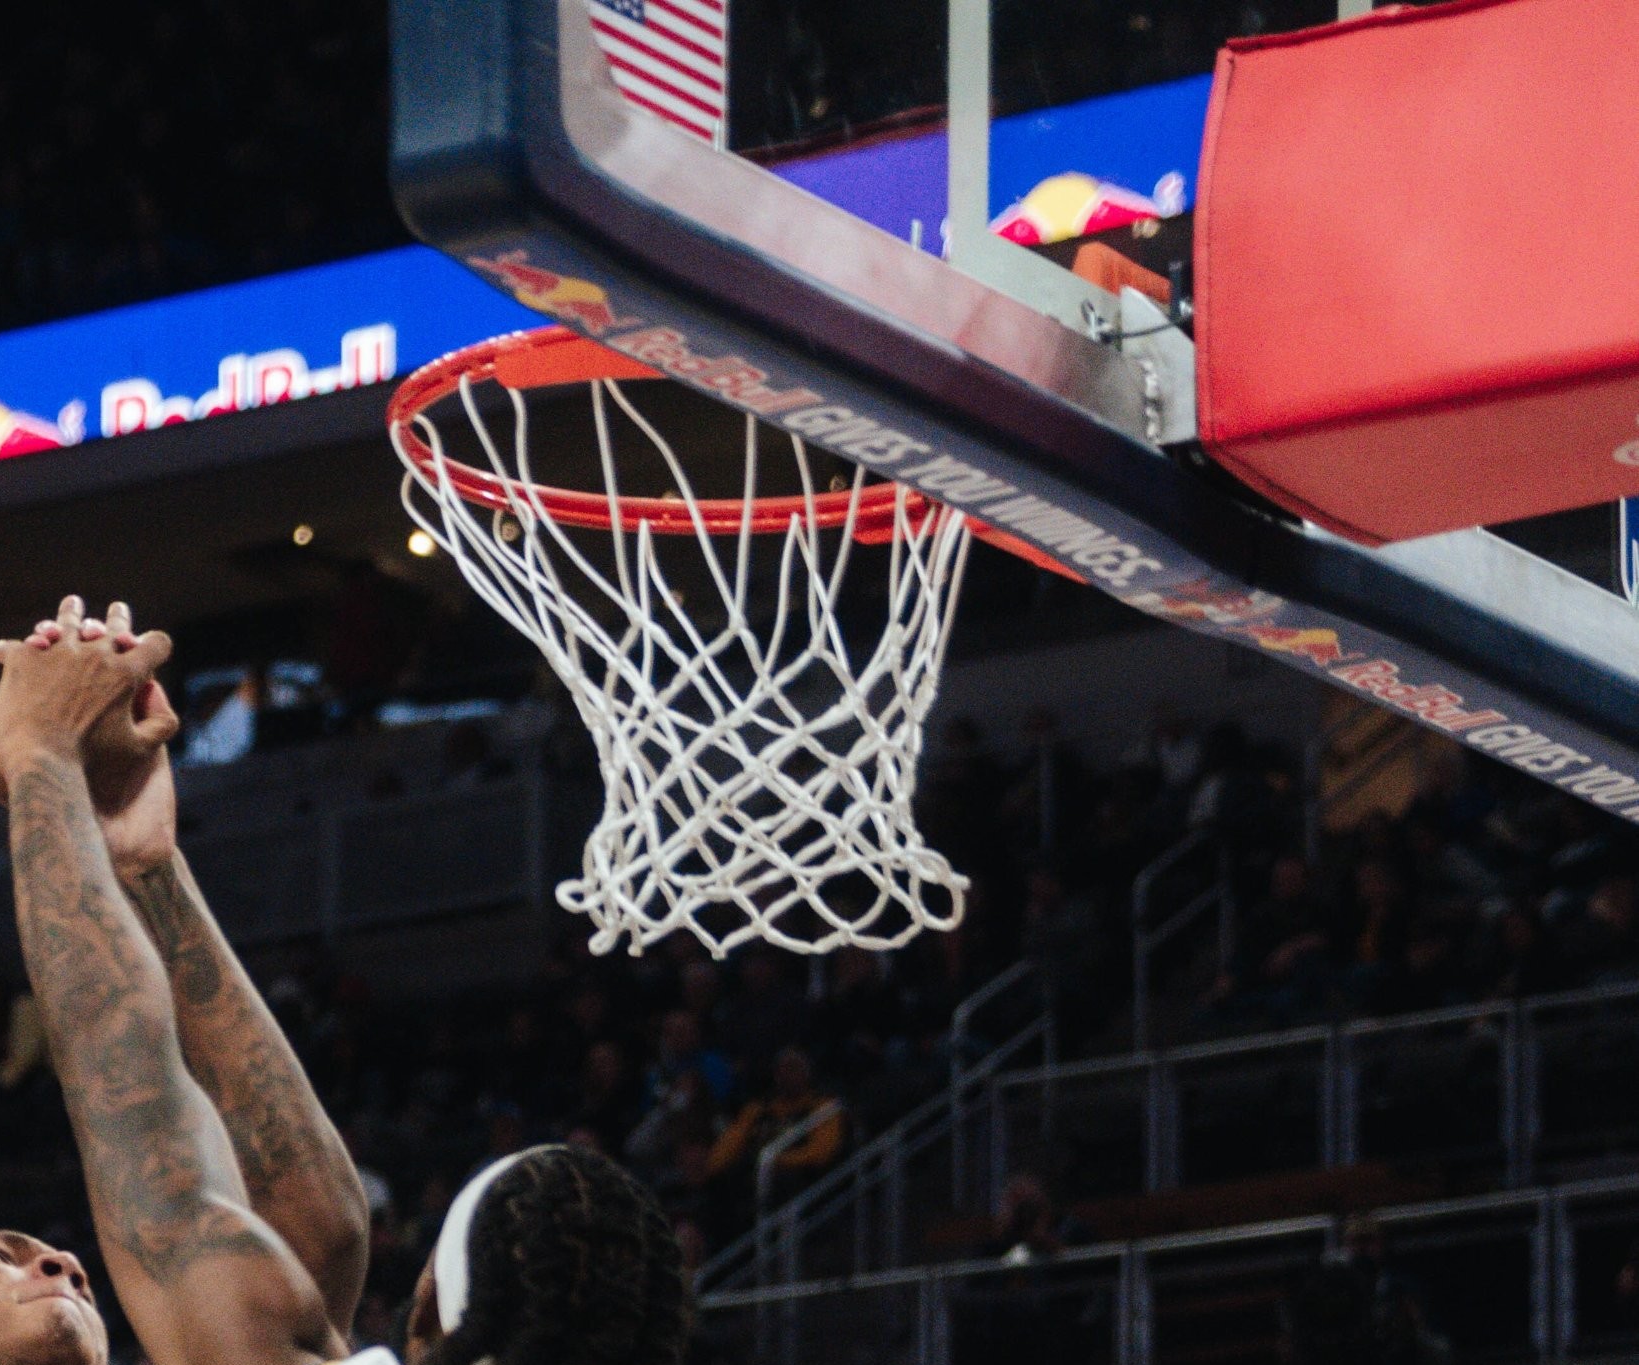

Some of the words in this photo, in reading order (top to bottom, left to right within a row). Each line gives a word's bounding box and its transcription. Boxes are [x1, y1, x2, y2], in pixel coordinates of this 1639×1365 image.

[783, 405, 933, 465] GIVES
[899, 455, 1019, 502] YOU
[1466, 724, 1592, 773] GIVES
